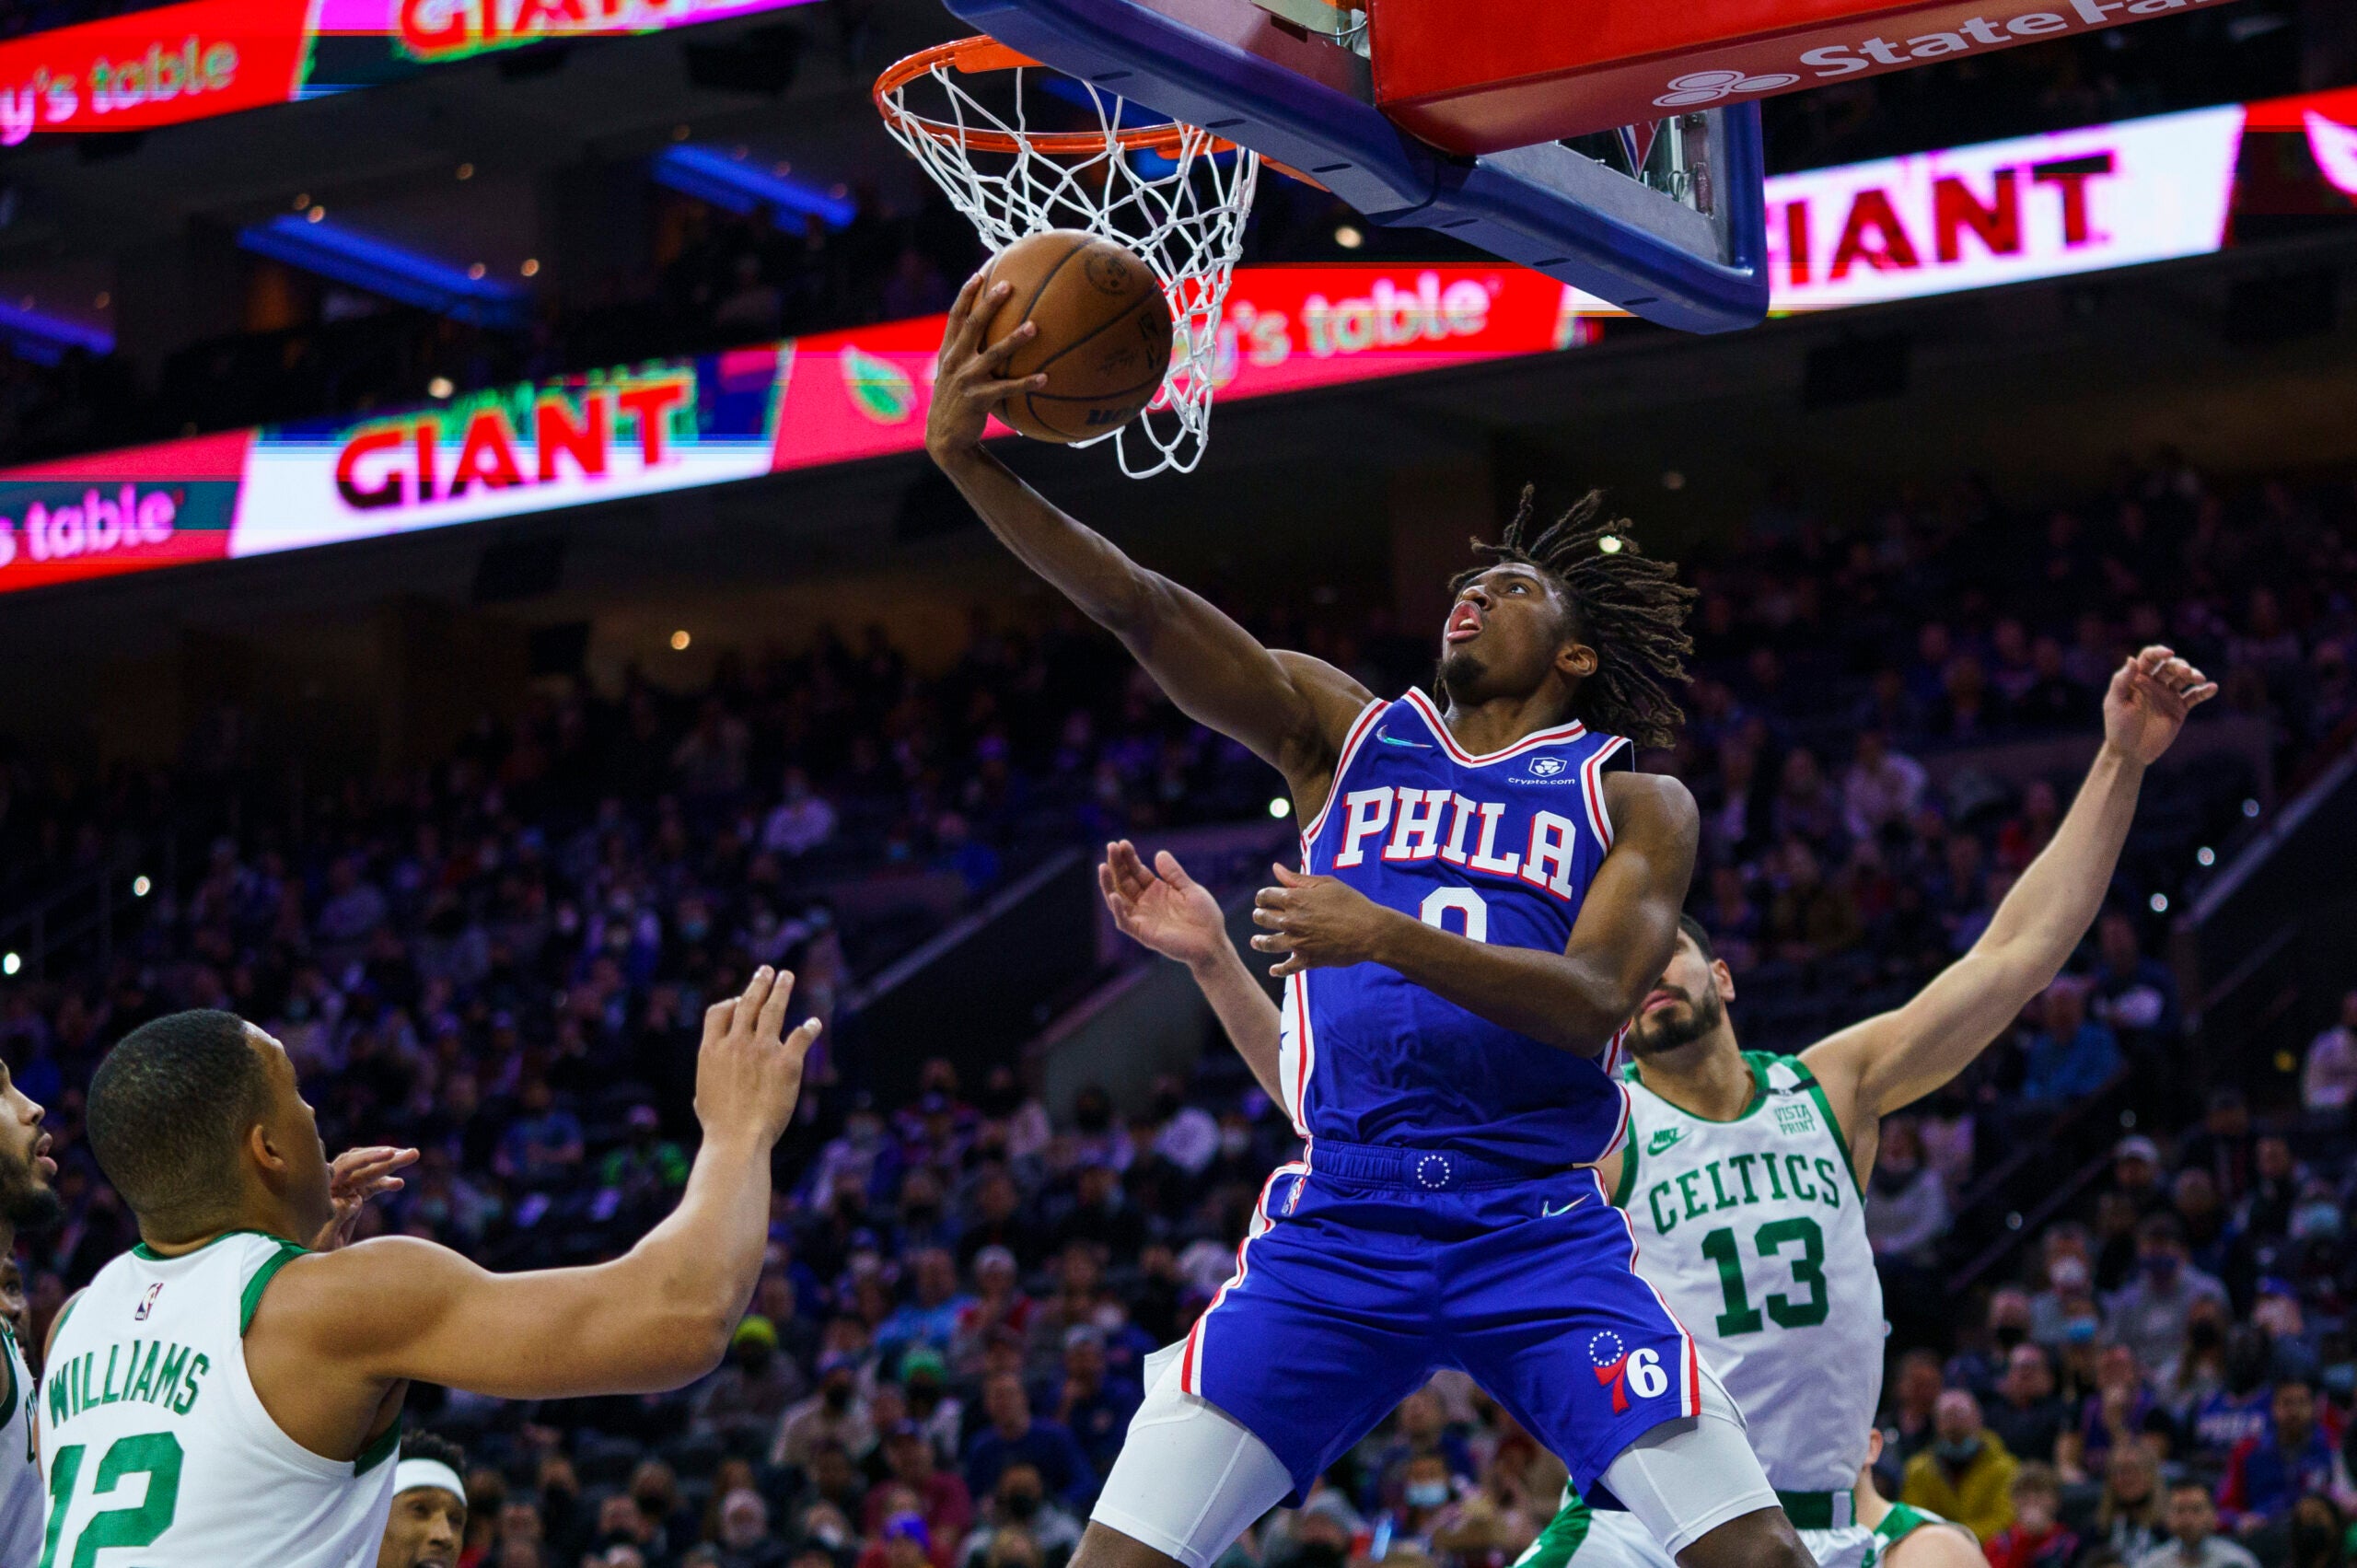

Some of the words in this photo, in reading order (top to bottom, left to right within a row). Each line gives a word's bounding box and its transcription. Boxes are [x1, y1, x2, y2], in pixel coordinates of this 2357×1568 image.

[89, 34, 238, 114] table
[1766, 151, 2114, 286] IANT
[1301, 270, 1491, 359] table
[336, 376, 684, 509] GIANT
[25, 482, 176, 562] table
[1507, 777, 1575, 785] crypto.com
[1332, 785, 1577, 902] PHILA
[1653, 1127, 1678, 1144] NIKE
[1773, 1104, 1814, 1122] VISTA
[1779, 1119, 1817, 1135] PRINT
[1649, 1153, 1840, 1235] CELTICS
[1701, 1216, 1829, 1338] 13
[49, 1339, 211, 1430] WILLIAMS
[1593, 1347, 1668, 1414] 76
[39, 1431, 185, 1568] 12
